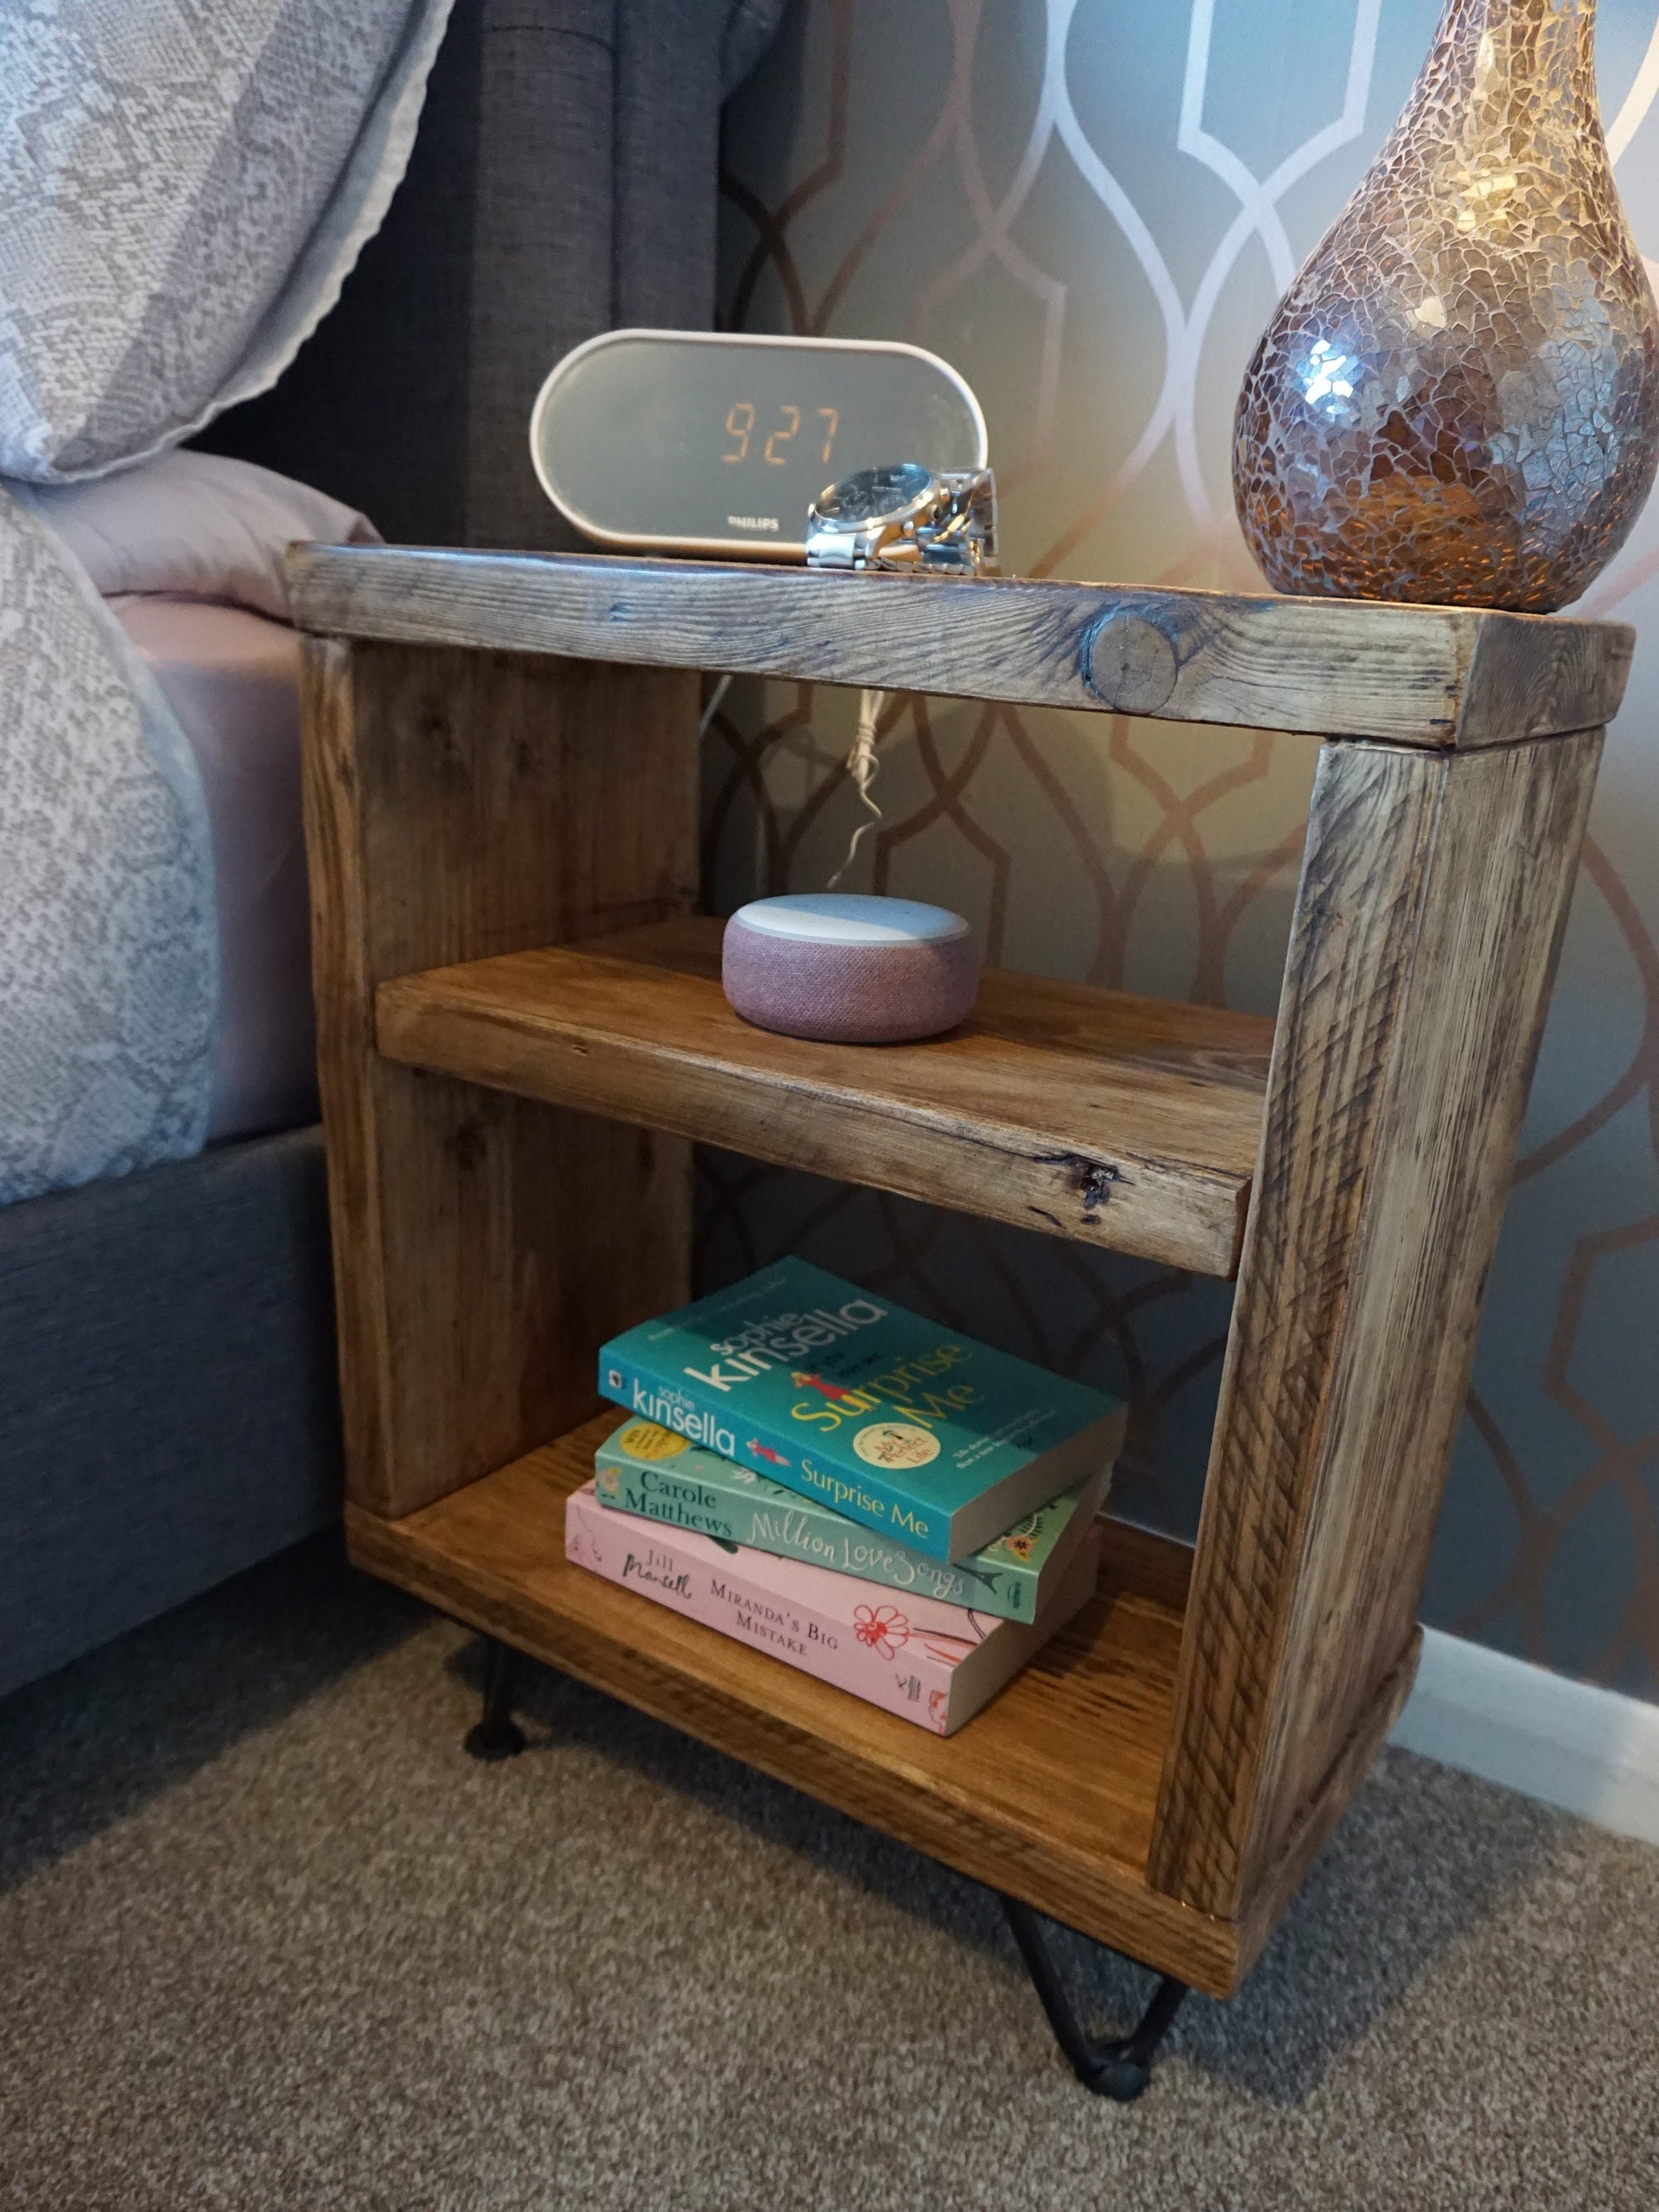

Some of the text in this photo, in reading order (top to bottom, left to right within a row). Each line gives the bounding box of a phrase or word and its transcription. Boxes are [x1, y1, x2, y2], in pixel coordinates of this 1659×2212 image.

[727, 515, 780, 532] PHILIPS
[683, 1299, 888, 1392] kinsella
[710, 1313, 803, 1356] sophie
[659, 1386, 695, 1411] sophie
[791, 1346, 971, 1432] Surprise
[893, 1385, 985, 1429] Me
[633, 1378, 735, 1457] kinsella
[625, 1488, 732, 1537] Matthews
[640, 1471, 717, 1508] Carole
[801, 1459, 929, 1538] Surprise Me
[622, 1553, 692, 1600] Mansell
[645, 1549, 673, 1572] Jill
[747, 1510, 837, 1562] Million
[839, 1537, 894, 1572] Love
[893, 1550, 964, 1600] Songs
